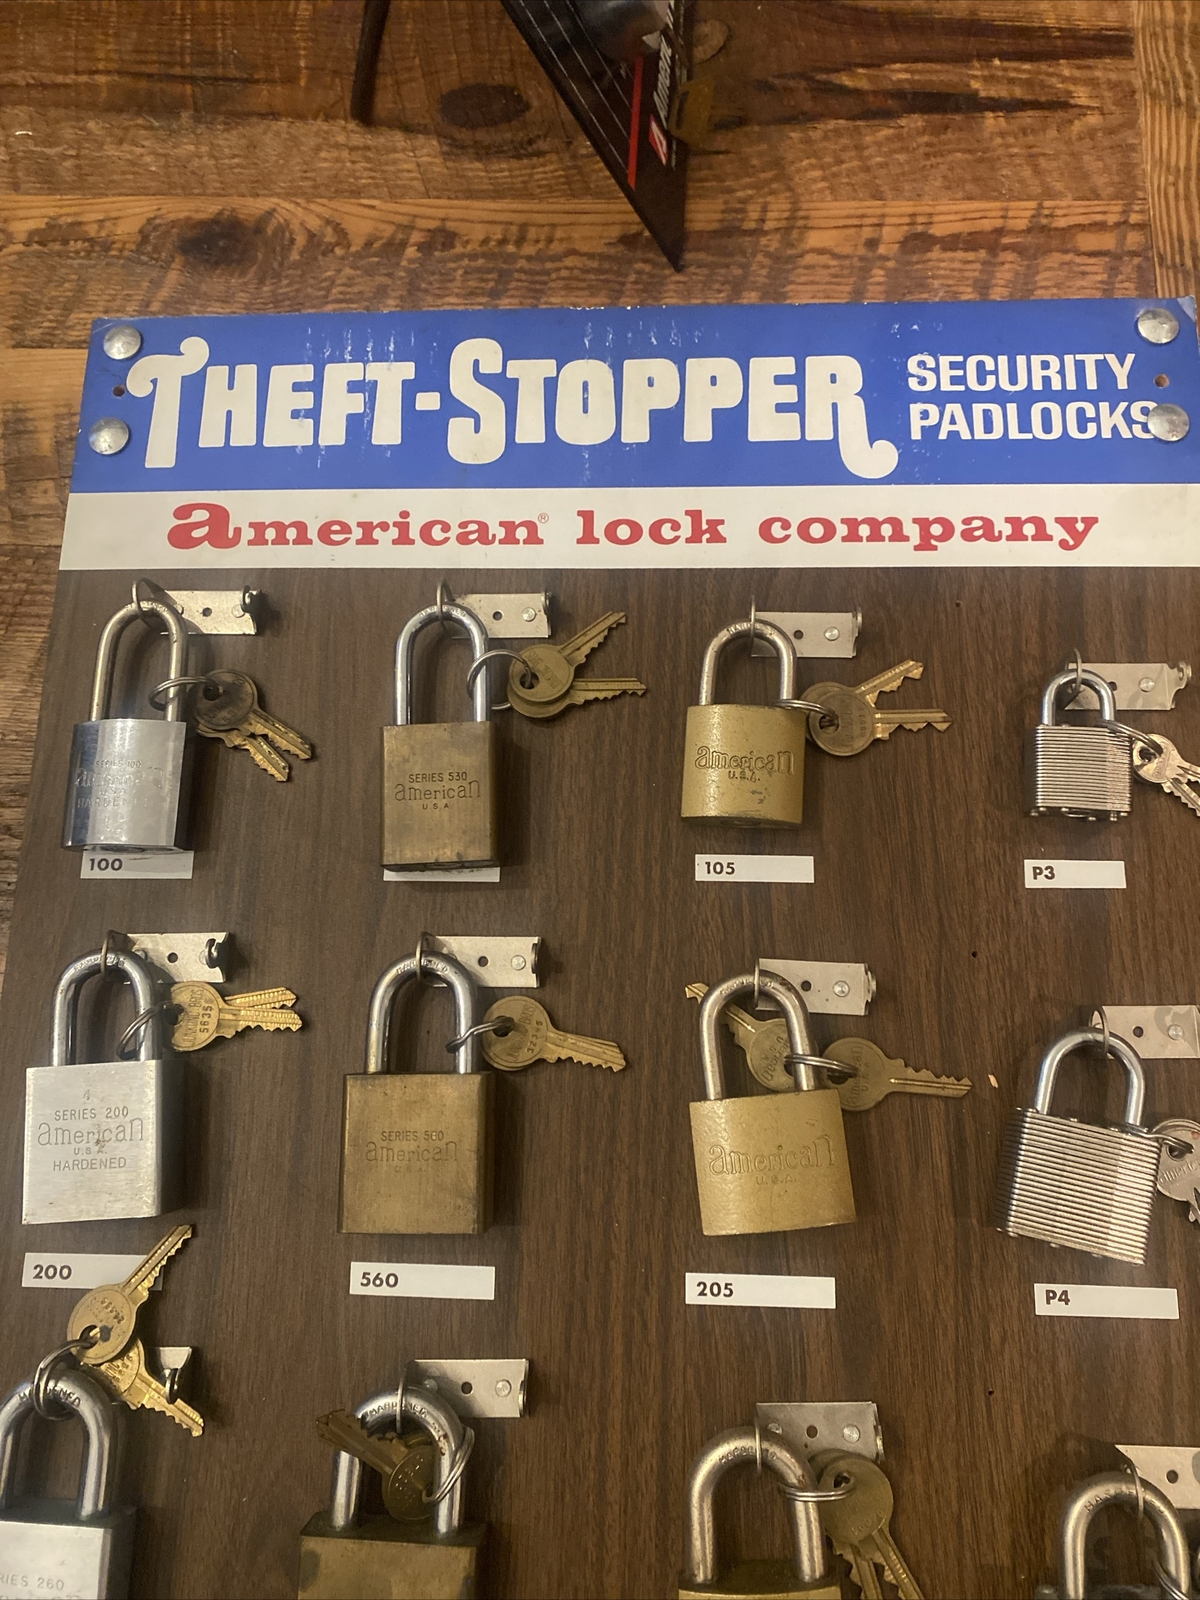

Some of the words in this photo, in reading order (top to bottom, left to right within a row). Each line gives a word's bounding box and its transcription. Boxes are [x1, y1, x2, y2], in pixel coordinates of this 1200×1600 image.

[907, 353, 1136, 393] SECURITY
[126, 336, 899, 480] THEFT-STOPPER
[576, 509, 728, 546] lock
[757, 514, 1099, 552] company
[127, 760, 142, 768] 100
[694, 745, 795, 775] american
[408, 772, 444, 784] SERIES
[448, 771, 468, 781] 530
[394, 779, 481, 802] american
[89, 857, 124, 872] 100
[704, 861, 736, 876] 105
[1032, 865, 1056, 881] P3
[54, 1107, 96, 1122] SERIES
[105, 1105, 129, 1119] 200
[37, 1117, 144, 1147] american
[380, 1130, 419, 1142] SERIES
[365, 1140, 459, 1163] american
[707, 1134, 837, 1176] american
[52, 1156, 127, 1172] HARDENED
[32, 1264, 73, 1281] 200
[359, 1271, 400, 1289] 560
[696, 1281, 734, 1298] 205
[1045, 1289, 1071, 1306] P4
[37, 1576, 66, 1592] 260
